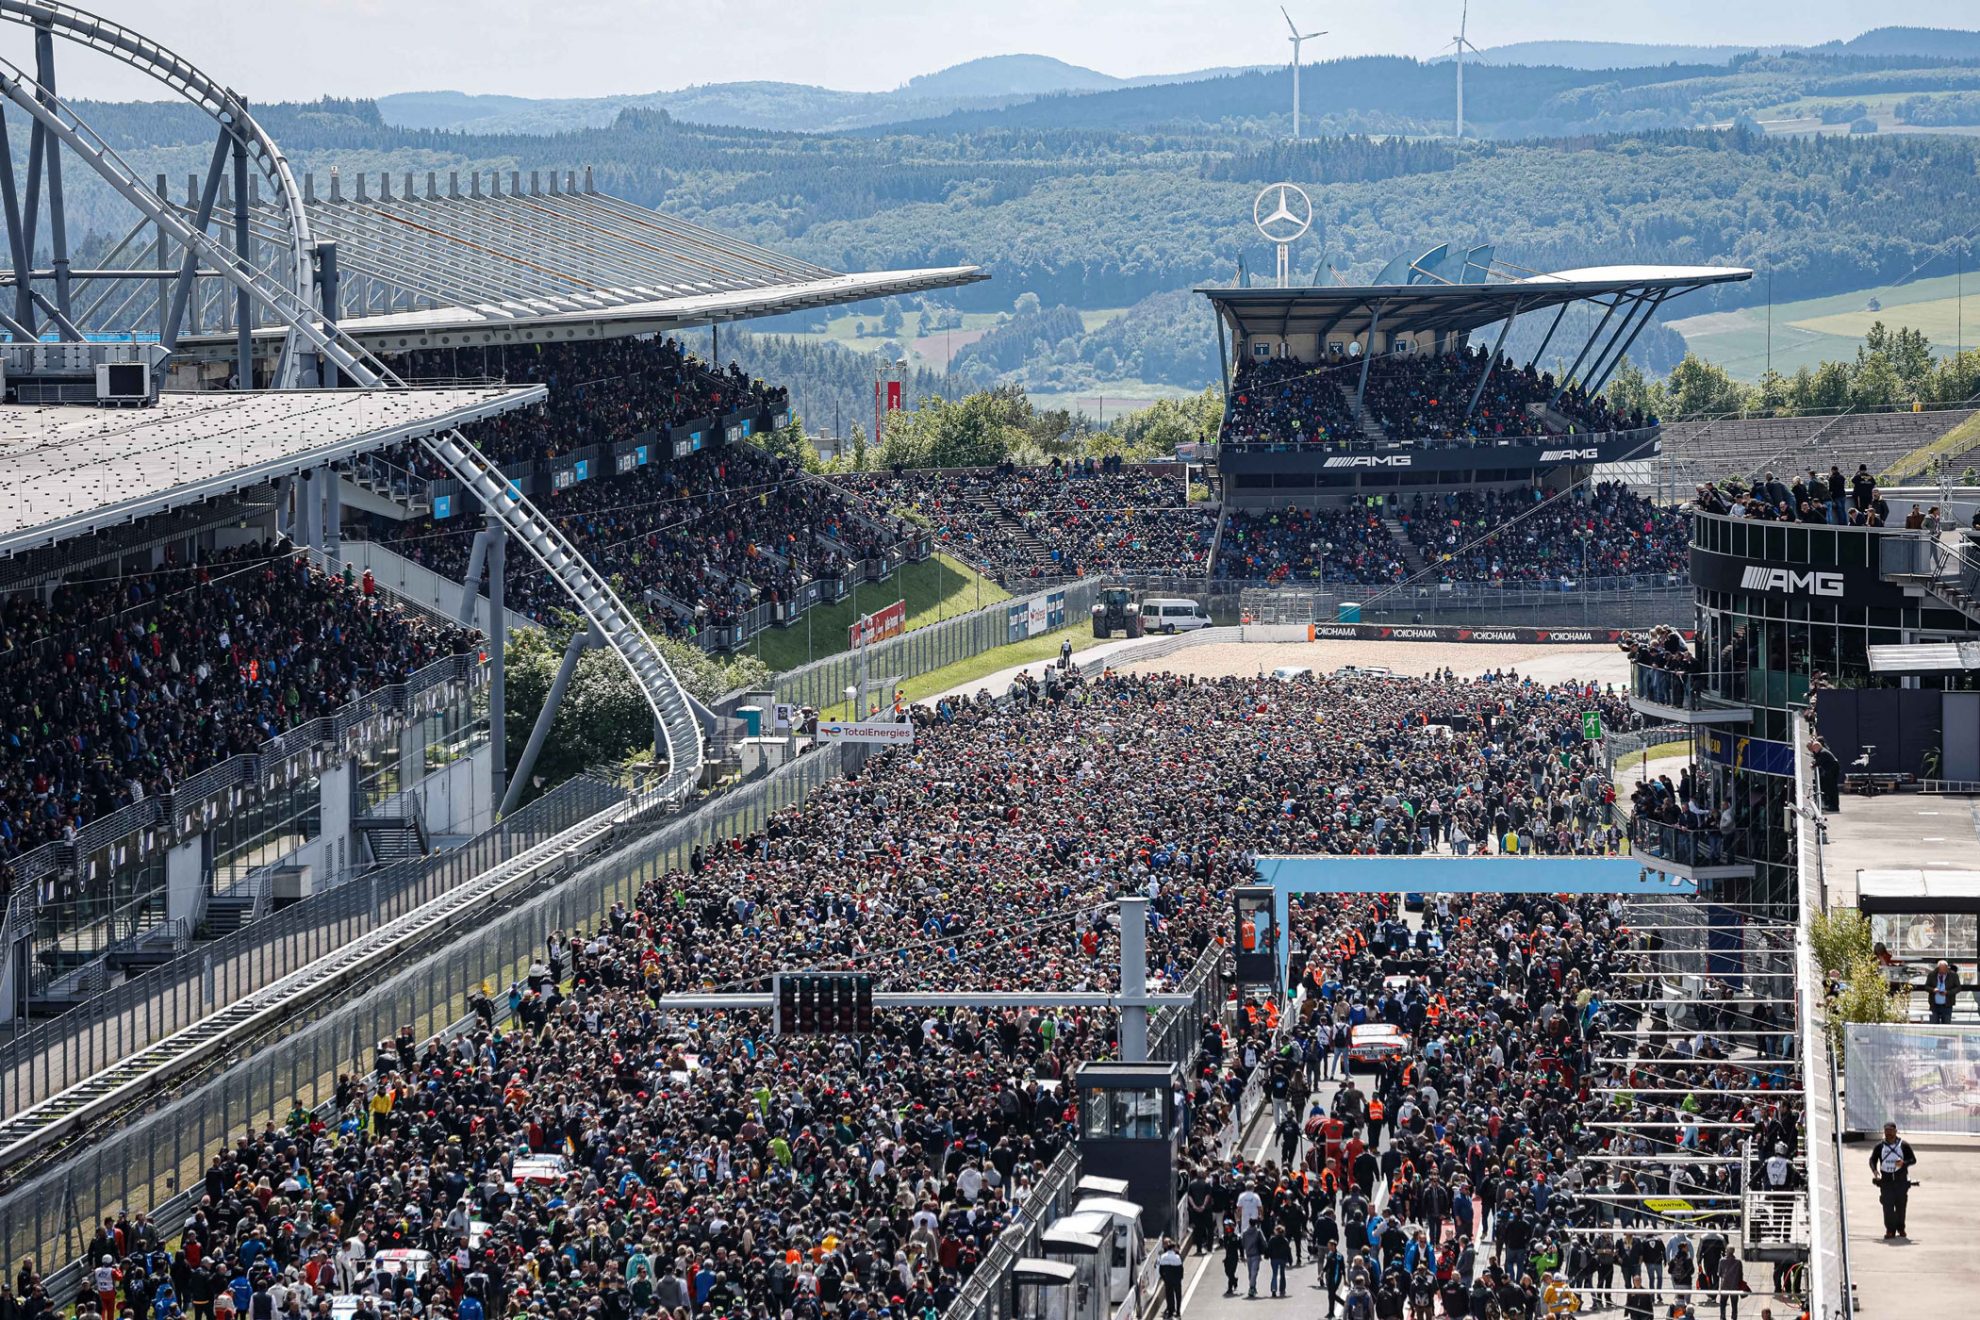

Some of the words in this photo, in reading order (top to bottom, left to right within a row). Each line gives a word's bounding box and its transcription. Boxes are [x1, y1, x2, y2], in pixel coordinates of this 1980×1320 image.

[1560, 448, 1598, 459] AMG
[1350, 455, 1412, 467] AMG
[1765, 567, 1844, 597] AMG
[1392, 629, 1437, 638] YOKOHAMA
[1472, 631, 1517, 641] YOKOHAMA
[1550, 632, 1592, 641] YOKOHAMA
[843, 726, 910, 739] TotalEnergies
